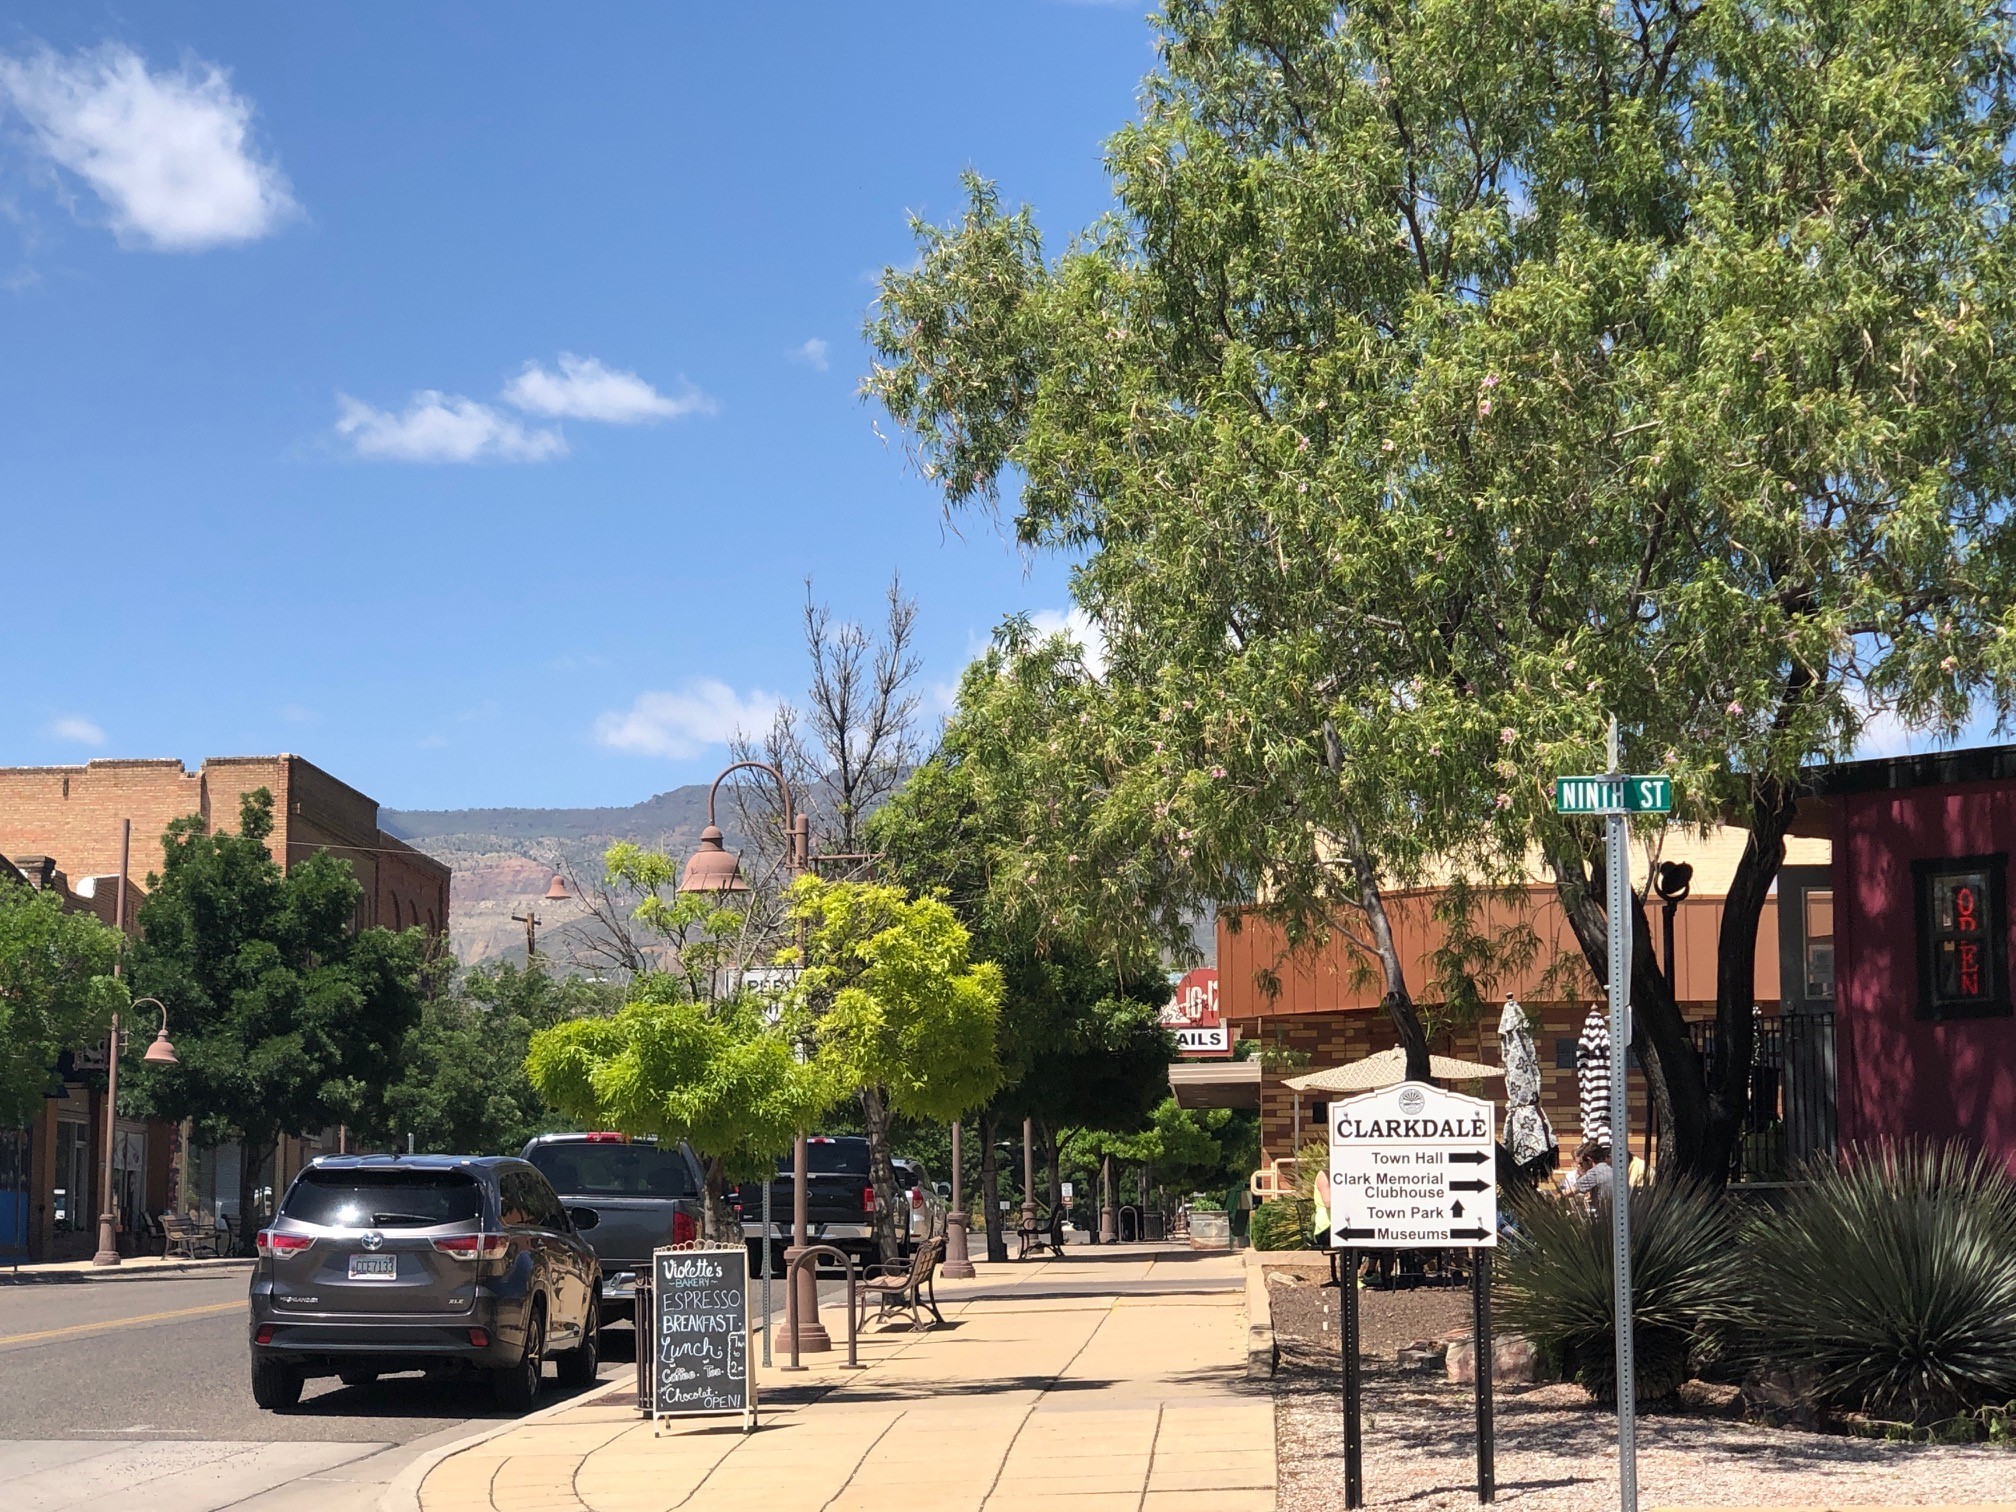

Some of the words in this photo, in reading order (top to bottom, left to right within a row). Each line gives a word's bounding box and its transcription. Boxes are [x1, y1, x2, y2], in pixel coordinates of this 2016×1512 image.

[1562, 781, 1625, 808] NINTH
[1640, 781, 1664, 808] ST
[1177, 1032, 1221, 1046] AILS
[1336, 1118, 1487, 1138] CLARKDALE
[1372, 1152, 1410, 1164] Town
[1415, 1152, 1443, 1164] Hall
[1333, 1172, 1371, 1185] Clark
[1376, 1172, 1443, 1185] Memorial
[1364, 1186, 1445, 1199] Clubhouse
[1367, 1206, 1405, 1219] Town
[1411, 1206, 1444, 1219] Park
[1377, 1228, 1448, 1240] Museums
[663, 1258, 723, 1279] Violette's
[675, 1279, 710, 1288] BAKERY
[663, 1289, 741, 1312] ESPRESSO
[663, 1314, 738, 1334] BREAKFAST
[661, 1336, 723, 1363] Lunch
[665, 1386, 714, 1403] Chocolat
[704, 1394, 741, 1409] OPEN!
